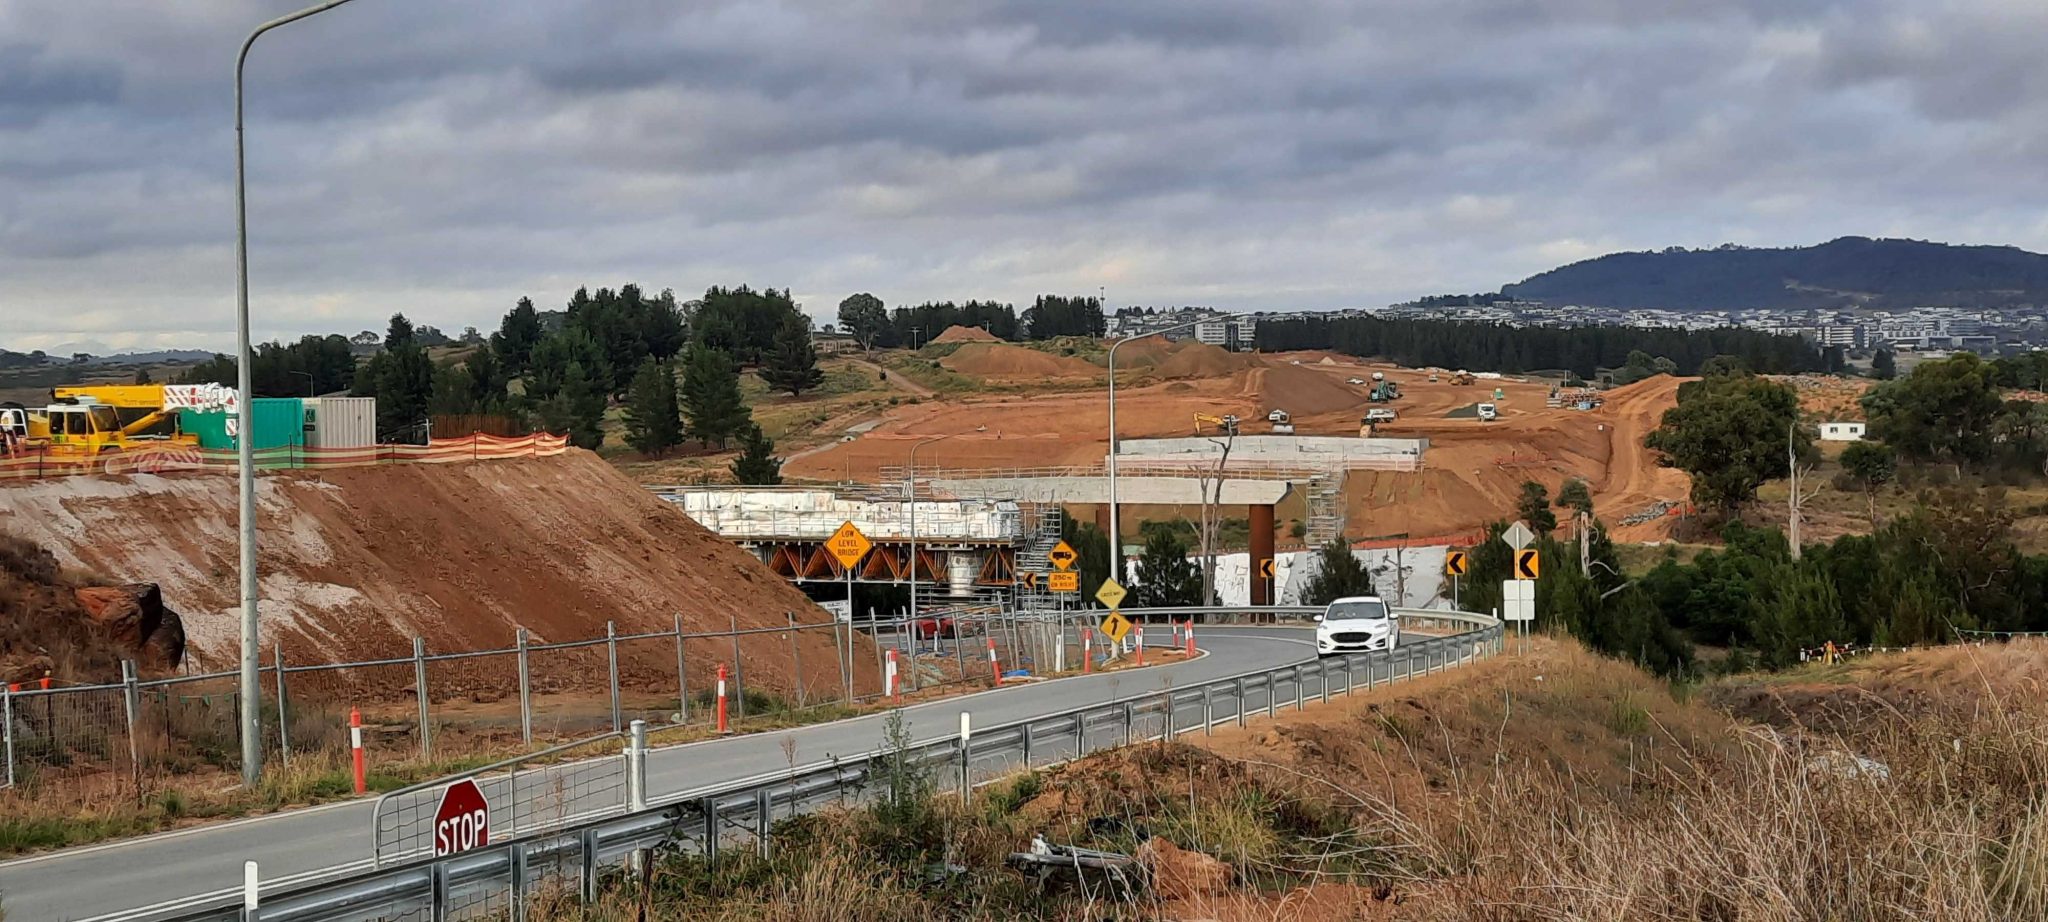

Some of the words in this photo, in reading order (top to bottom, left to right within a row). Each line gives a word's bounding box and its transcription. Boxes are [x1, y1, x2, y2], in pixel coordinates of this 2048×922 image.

[841, 530, 854, 538] LOW
[837, 548, 860, 556] BRIDGE
[438, 809, 485, 856] STOP
